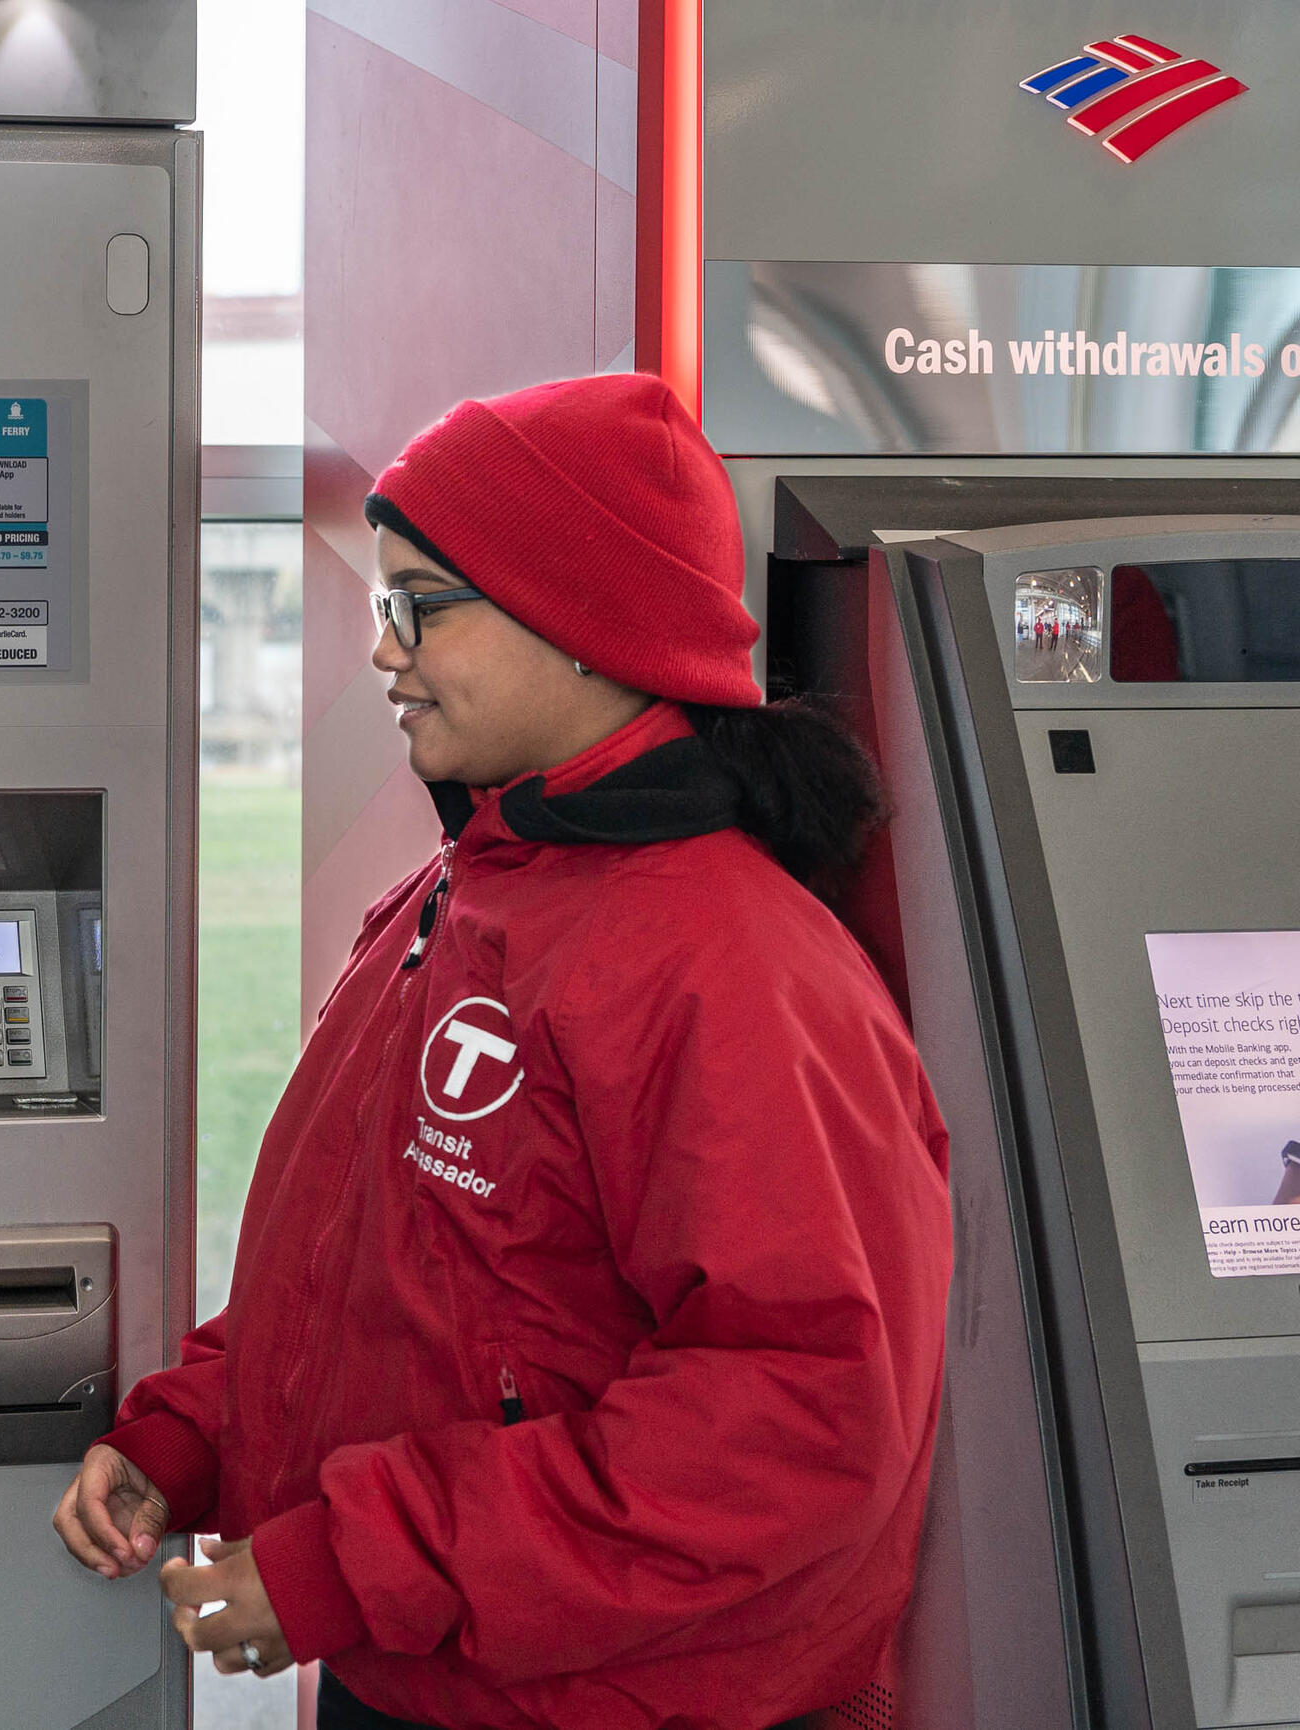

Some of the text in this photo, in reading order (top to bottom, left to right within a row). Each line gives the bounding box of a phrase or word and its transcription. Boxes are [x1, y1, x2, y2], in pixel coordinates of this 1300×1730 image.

[885, 328, 993, 375] Cash
[1009, 329, 1265, 377] withdrawals
[2, 427, 30, 436] FERRY
[0, 471, 15, 480] App
[4, 533, 40, 543] PRICING
[1156, 991, 1293, 1011] Next time skip the
[1161, 1018, 1220, 1037] Deposit
[1223, 1016, 1275, 1033] checks
[1167, 1044, 1188, 1055] With
[1189, 1045, 1204, 1054] the
[1205, 1044, 1235, 1054] Mobile
[1237, 1043, 1272, 1054] Banking
[1187, 1060, 1203, 1068] can
[1204, 1057, 1237, 1069] deposit
[1238, 1056, 1268, 1066] checks
[1270, 1056, 1287, 1066] and
[1174, 1069, 1295, 1081] mmediate confirmation that
[1195, 1085, 1220, 1095] check
[1222, 1084, 1231, 1093] is
[1231, 1083, 1257, 1095] being
[416, 1116, 473, 1160] Transit
[1202, 1216, 1300, 1235] earn more
[1195, 1477, 1250, 1489] Take Receipt
